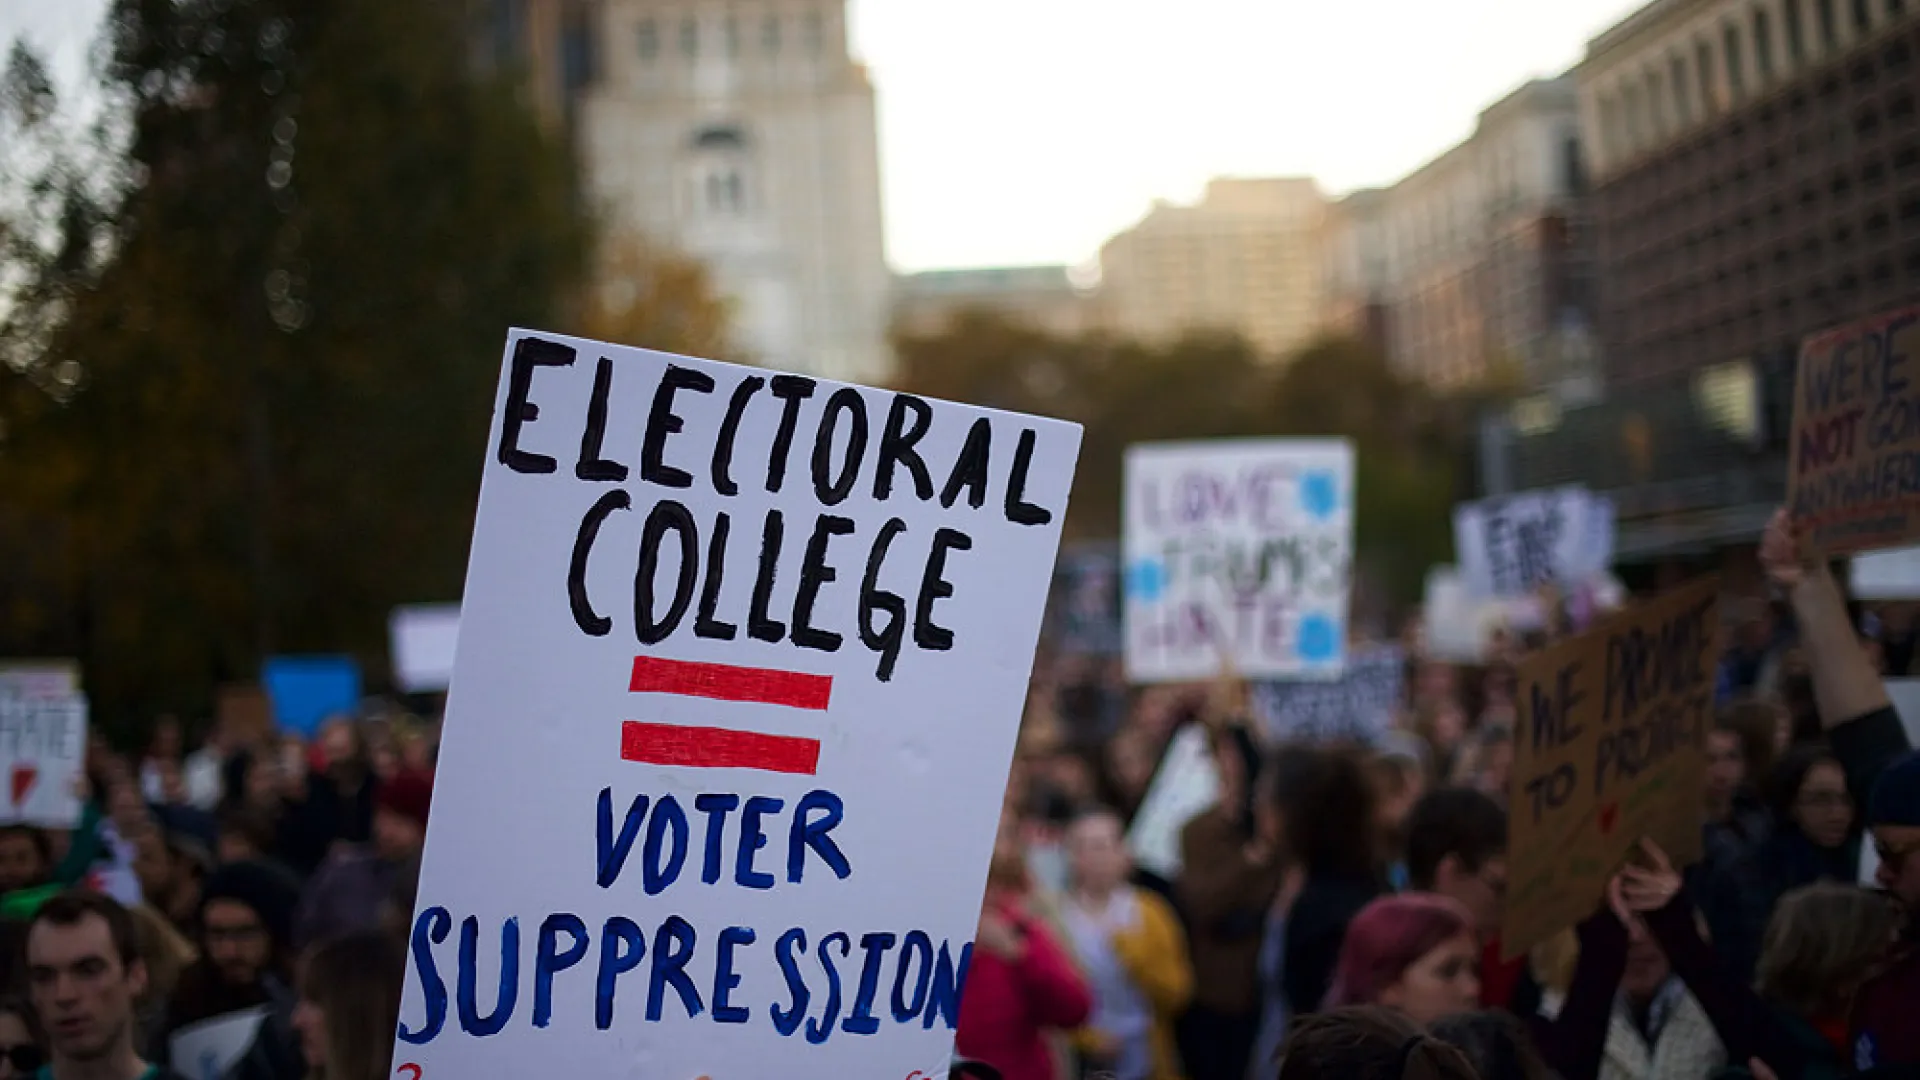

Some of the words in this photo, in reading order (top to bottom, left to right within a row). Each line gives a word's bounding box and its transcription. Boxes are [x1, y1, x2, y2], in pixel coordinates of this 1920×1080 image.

[499, 337, 1053, 526] ELECTORAL
[1798, 405, 1865, 475] NOT
[1140, 462, 1300, 531] LOVE
[567, 489, 973, 682] COLLEGE
[1530, 660, 1587, 749] WE
[596, 786, 851, 895] VOTER
[1525, 760, 1577, 825] TO
[397, 906, 974, 1044] SUPPRESSION
